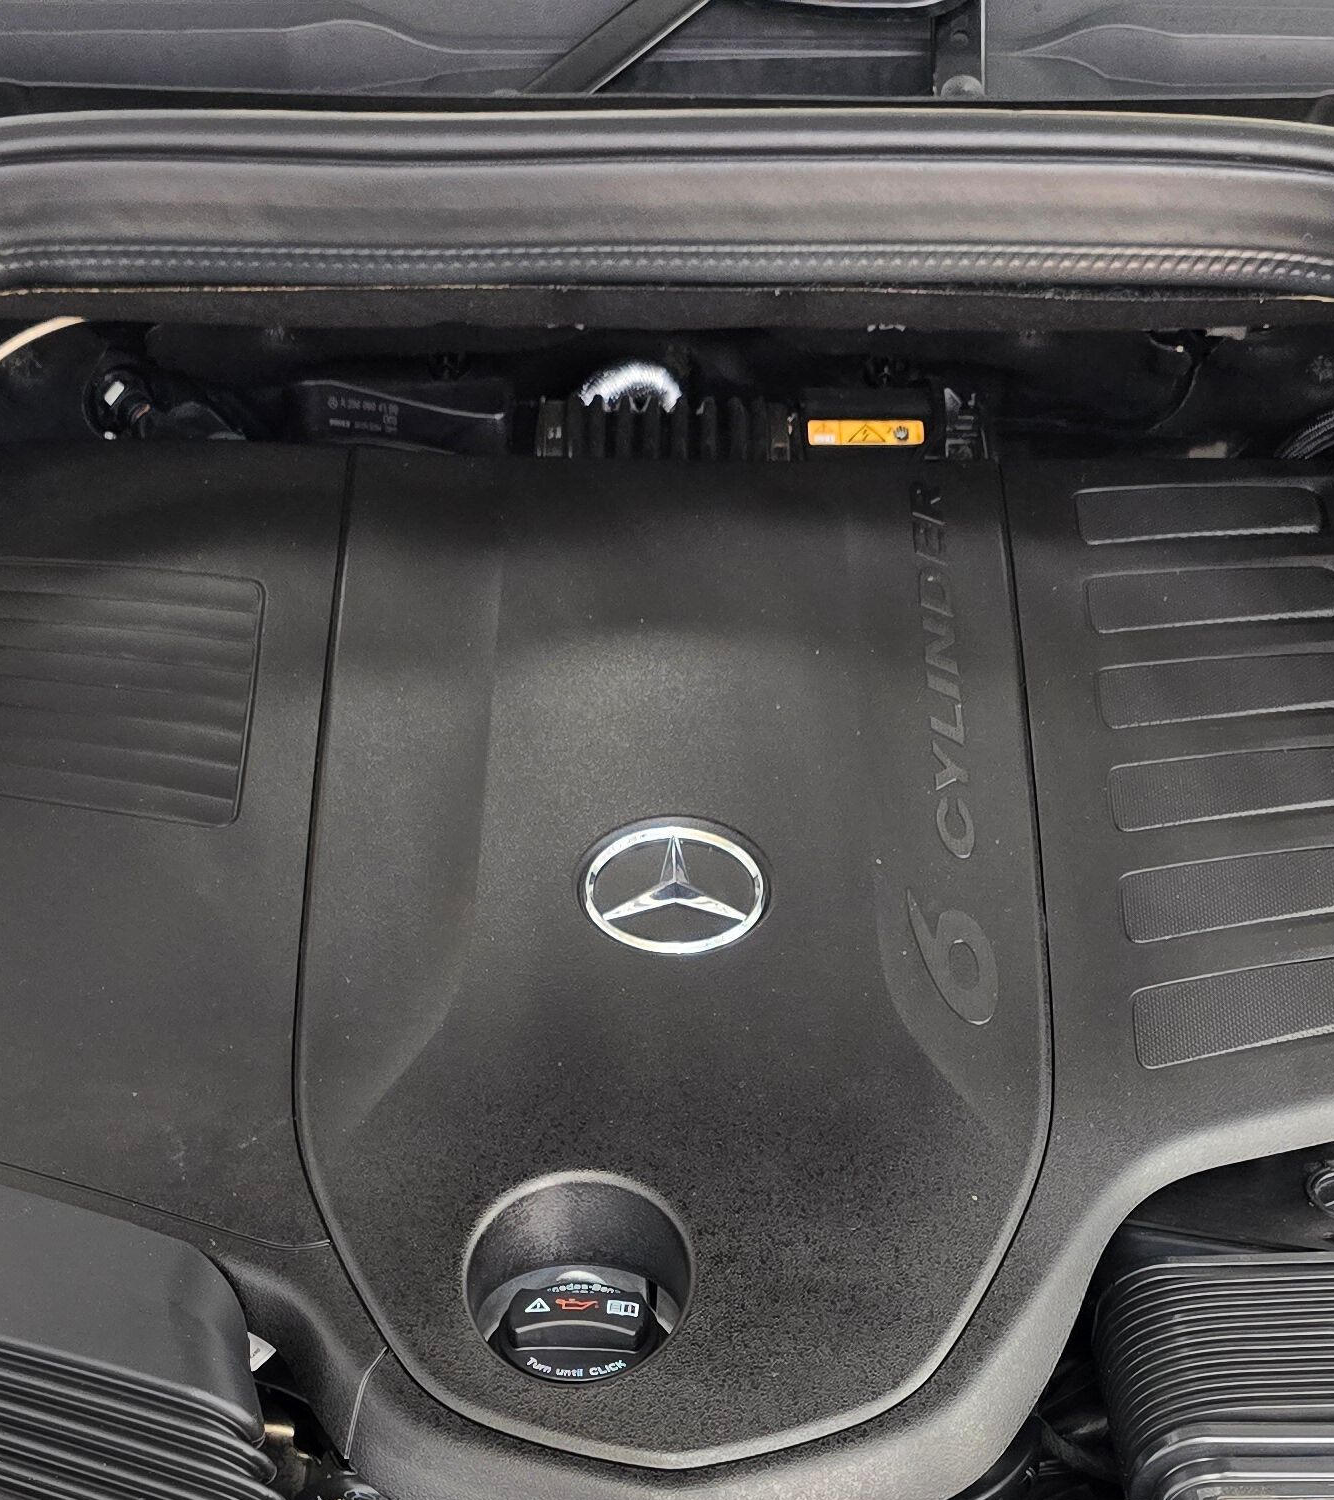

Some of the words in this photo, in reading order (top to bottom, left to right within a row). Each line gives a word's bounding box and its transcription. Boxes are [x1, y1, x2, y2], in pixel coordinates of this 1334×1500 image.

[908, 481, 976, 860] CYLINDER
[906, 886, 999, 1025] 6
[526, 1356, 552, 1374] Turn
[555, 1368, 584, 1377] until
[589, 1359, 627, 1376] CLICK
